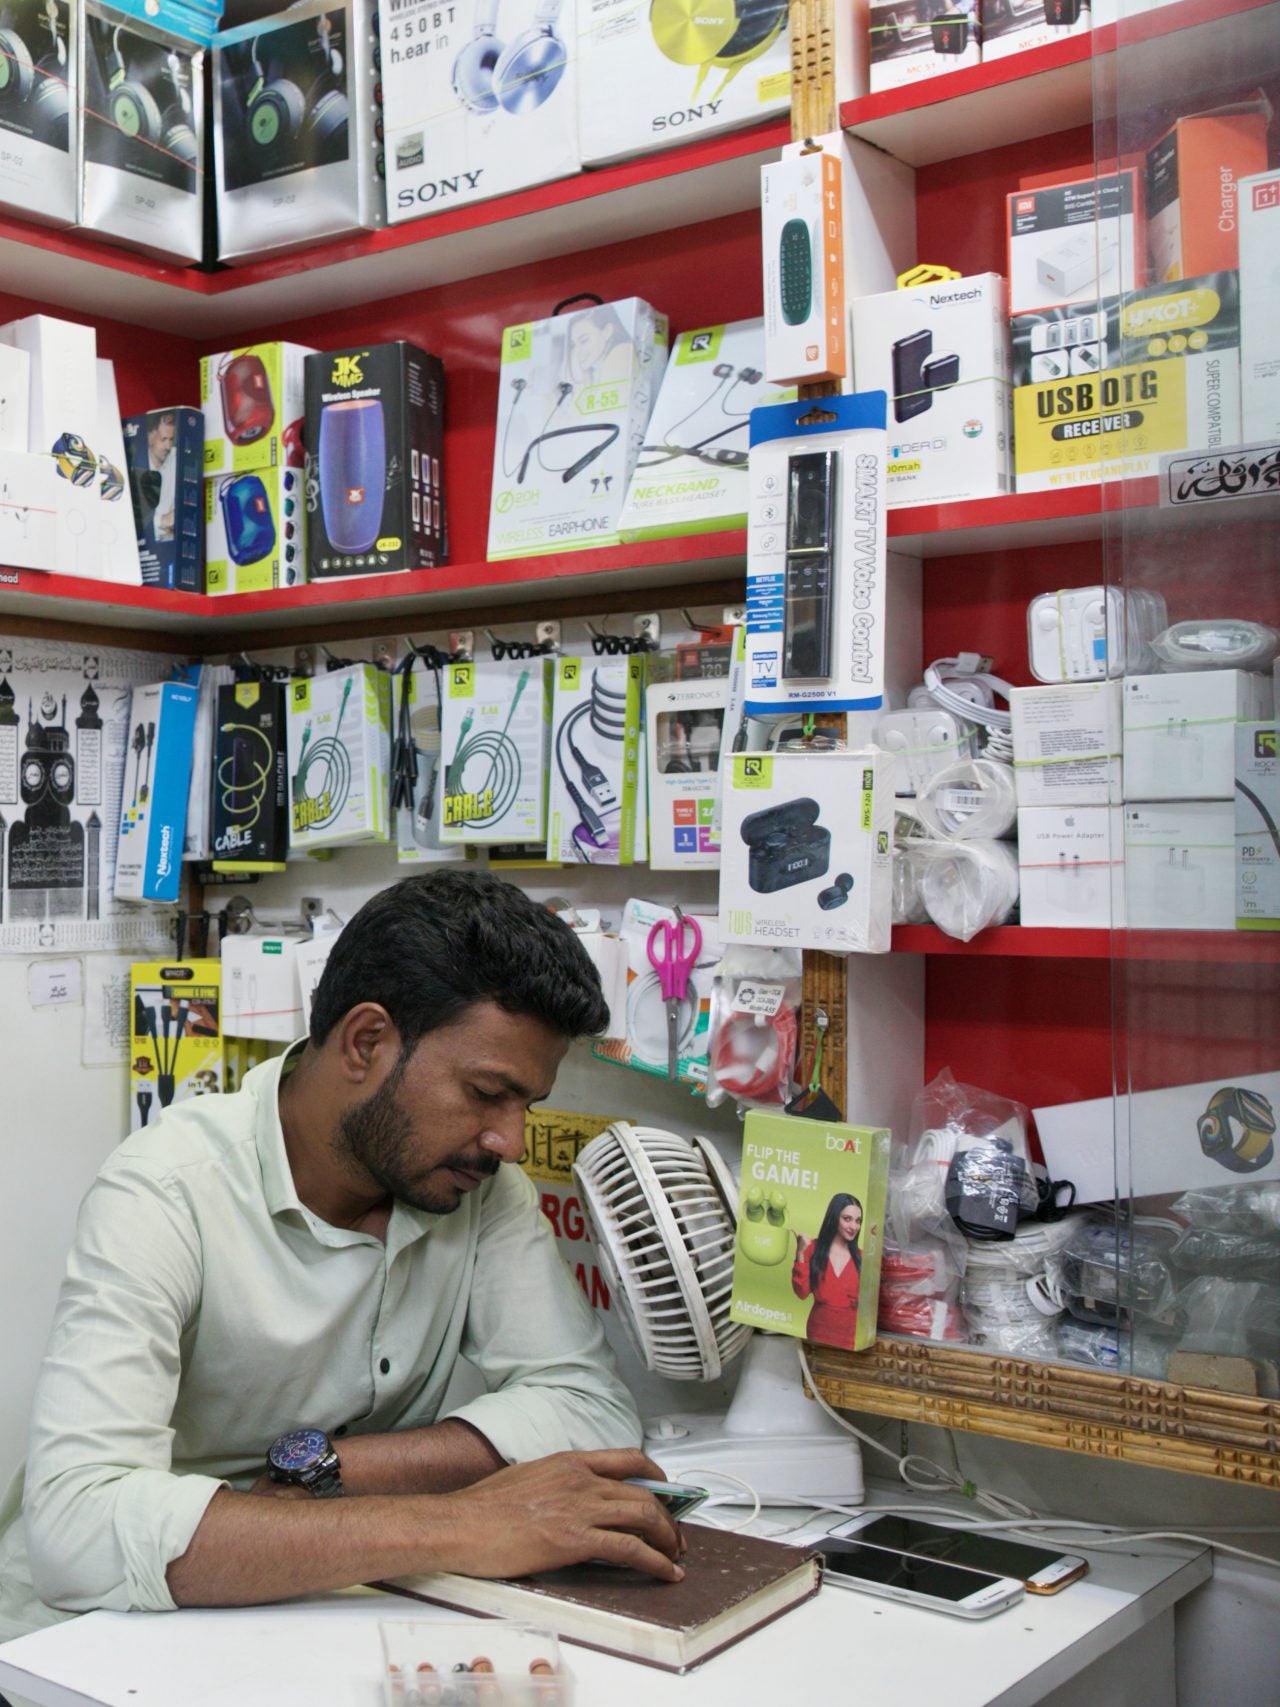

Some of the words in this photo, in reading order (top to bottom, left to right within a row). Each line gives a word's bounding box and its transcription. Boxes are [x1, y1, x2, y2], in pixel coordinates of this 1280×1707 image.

[694, 16, 726, 25] SONY
[390, 41, 431, 64] h.ear
[652, 99, 723, 131] SONY
[397, 169, 483, 208] SONY
[1218, 166, 1237, 232] Charger
[930, 289, 983, 305] Nextech
[1206, 359, 1221, 392] SUPER
[1037, 383, 1093, 418] USB
[1100, 370, 1158, 408] OTG
[1206, 393, 1222, 449] COMPATIBL
[633, 479, 719, 499] NECKBAND
[855, 454, 878, 525] SMART
[549, 516, 609, 537] EARPHONE
[854, 527, 877, 555] TV
[851, 612, 875, 683] Control
[756, 662, 774, 674] TV
[676, 690, 720, 700] ZEBRONICS
[443, 788, 494, 825] CABLE
[214, 830, 253, 851] CABLE
[1077, 831, 1105, 840] Adapter
[156, 825, 171, 876] Nextech
[1242, 847, 1255, 857] PD
[728, 911, 752, 935] TWS
[754, 926, 801, 938] HEADSET
[755, 917, 786, 927] WIRELESS
[746, 1143, 774, 1159] FLIP
[775, 1148, 801, 1165] THE
[826, 1133, 862, 1155] boAt
[751, 1161, 819, 1191] GAME!
[735, 1299, 786, 1320] Airdopes
